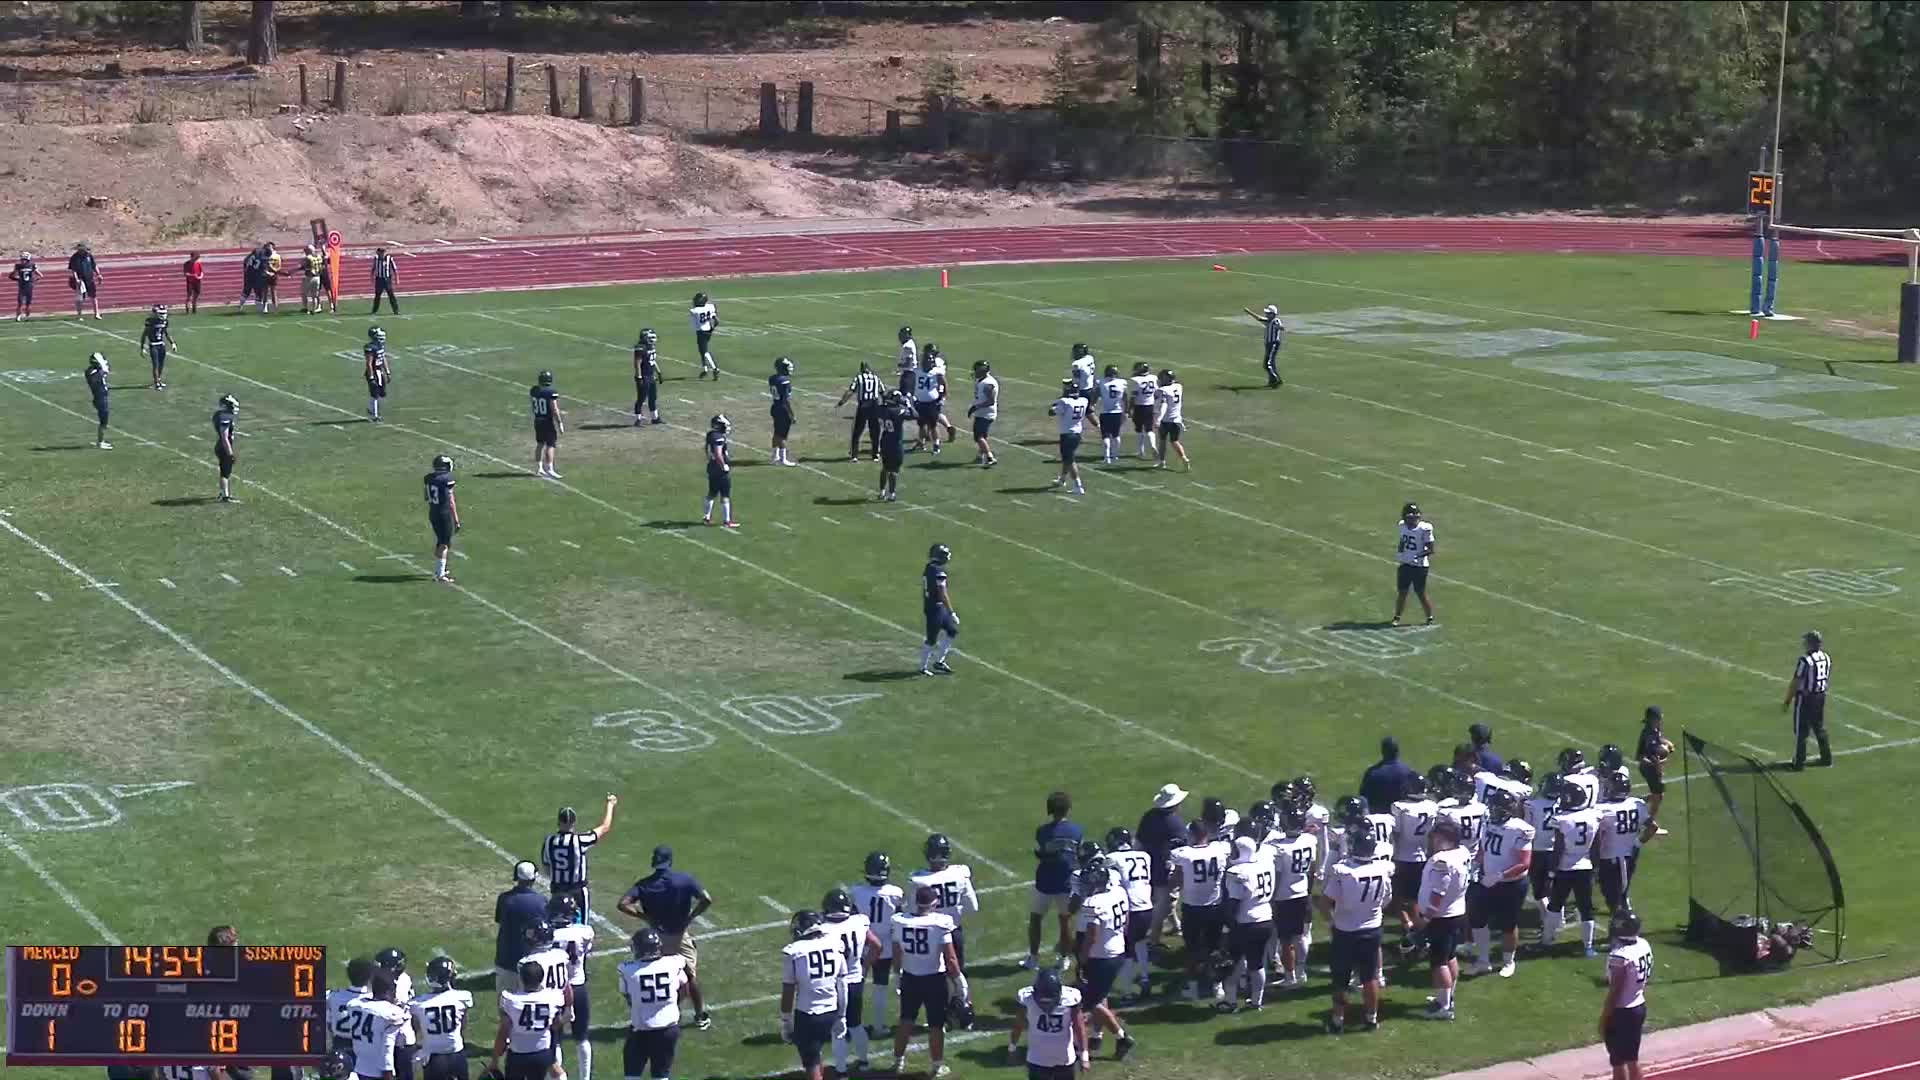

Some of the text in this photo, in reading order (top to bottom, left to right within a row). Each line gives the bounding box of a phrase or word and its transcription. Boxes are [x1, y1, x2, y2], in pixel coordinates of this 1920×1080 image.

[917, 377, 931, 391] 54
[592, 696, 843, 752] 30
[1460, 815, 1483, 840] 87
[1575, 822, 1588, 846] 3
[1617, 810, 1640, 834] 88
[1484, 830, 1503, 856] 70
[553, 849, 570, 870] S
[1126, 857, 1150, 881] 23
[1192, 858, 1219, 883] 94
[1257, 871, 1273, 899] 93
[1358, 875, 1384, 902] 77
[868, 896, 885, 924] 11
[901, 927, 929, 955] 58
[545, 964, 566, 989] 40
[809, 948, 836, 979] 95
[640, 972, 670, 1003] 55
[351, 1014, 374, 1043] 24
[424, 1005, 457, 1034] 30
[518, 1003, 550, 1031] 45
